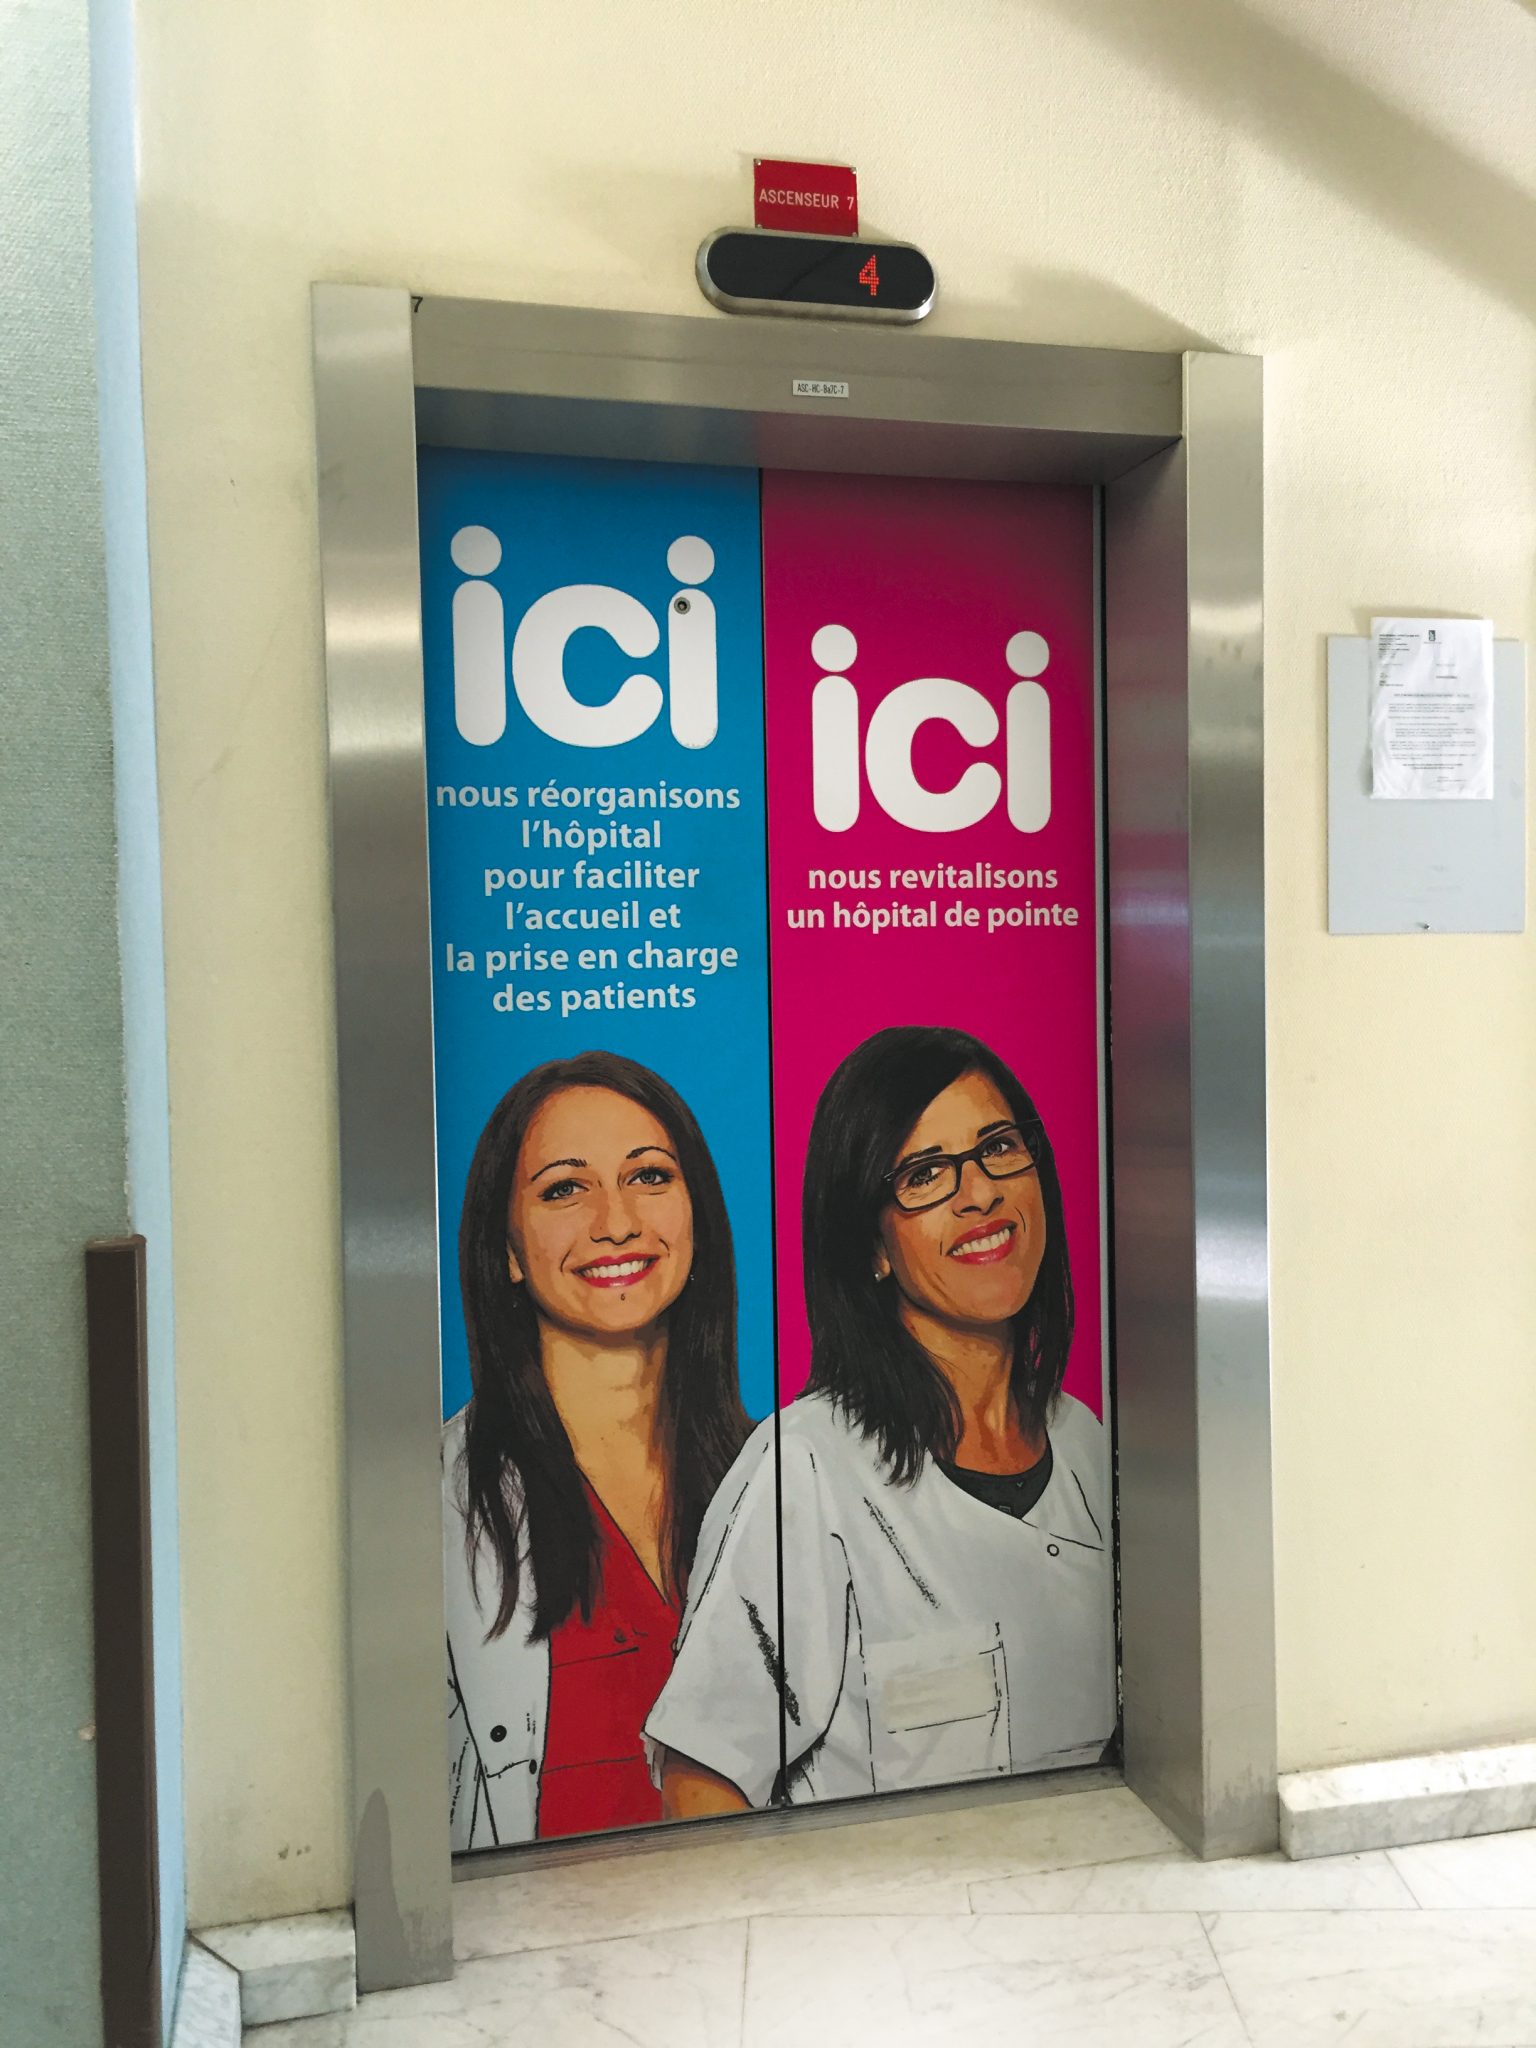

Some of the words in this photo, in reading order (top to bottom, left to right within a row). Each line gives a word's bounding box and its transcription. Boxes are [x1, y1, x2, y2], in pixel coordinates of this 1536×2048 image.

[759, 188, 839, 209] ASCENSEUR
[847, 196, 855, 211] 7
[859, 254, 879, 296] 4
[411, 296, 423, 313] 7
[450, 525, 718, 750] ici
[811, 624, 1051, 833] ici
[436, 785, 519, 807] nous
[527, 779, 741, 815] réorganisons
[484, 868, 565, 897] pour
[573, 860, 700, 889] faciliter
[808, 869, 882, 889] nous
[889, 862, 1058, 889] revitalisons
[648, 904, 681, 929] et
[787, 908, 825, 928] un
[833, 901, 937, 934] hôpital
[944, 901, 980, 927] de
[987, 901, 1079, 933] pointe
[446, 943, 475, 972] la
[485, 942, 569, 979] prise
[578, 947, 618, 969] en
[627, 940, 739, 975] charge
[492, 983, 552, 1012] des
[561, 981, 697, 1018] patients
